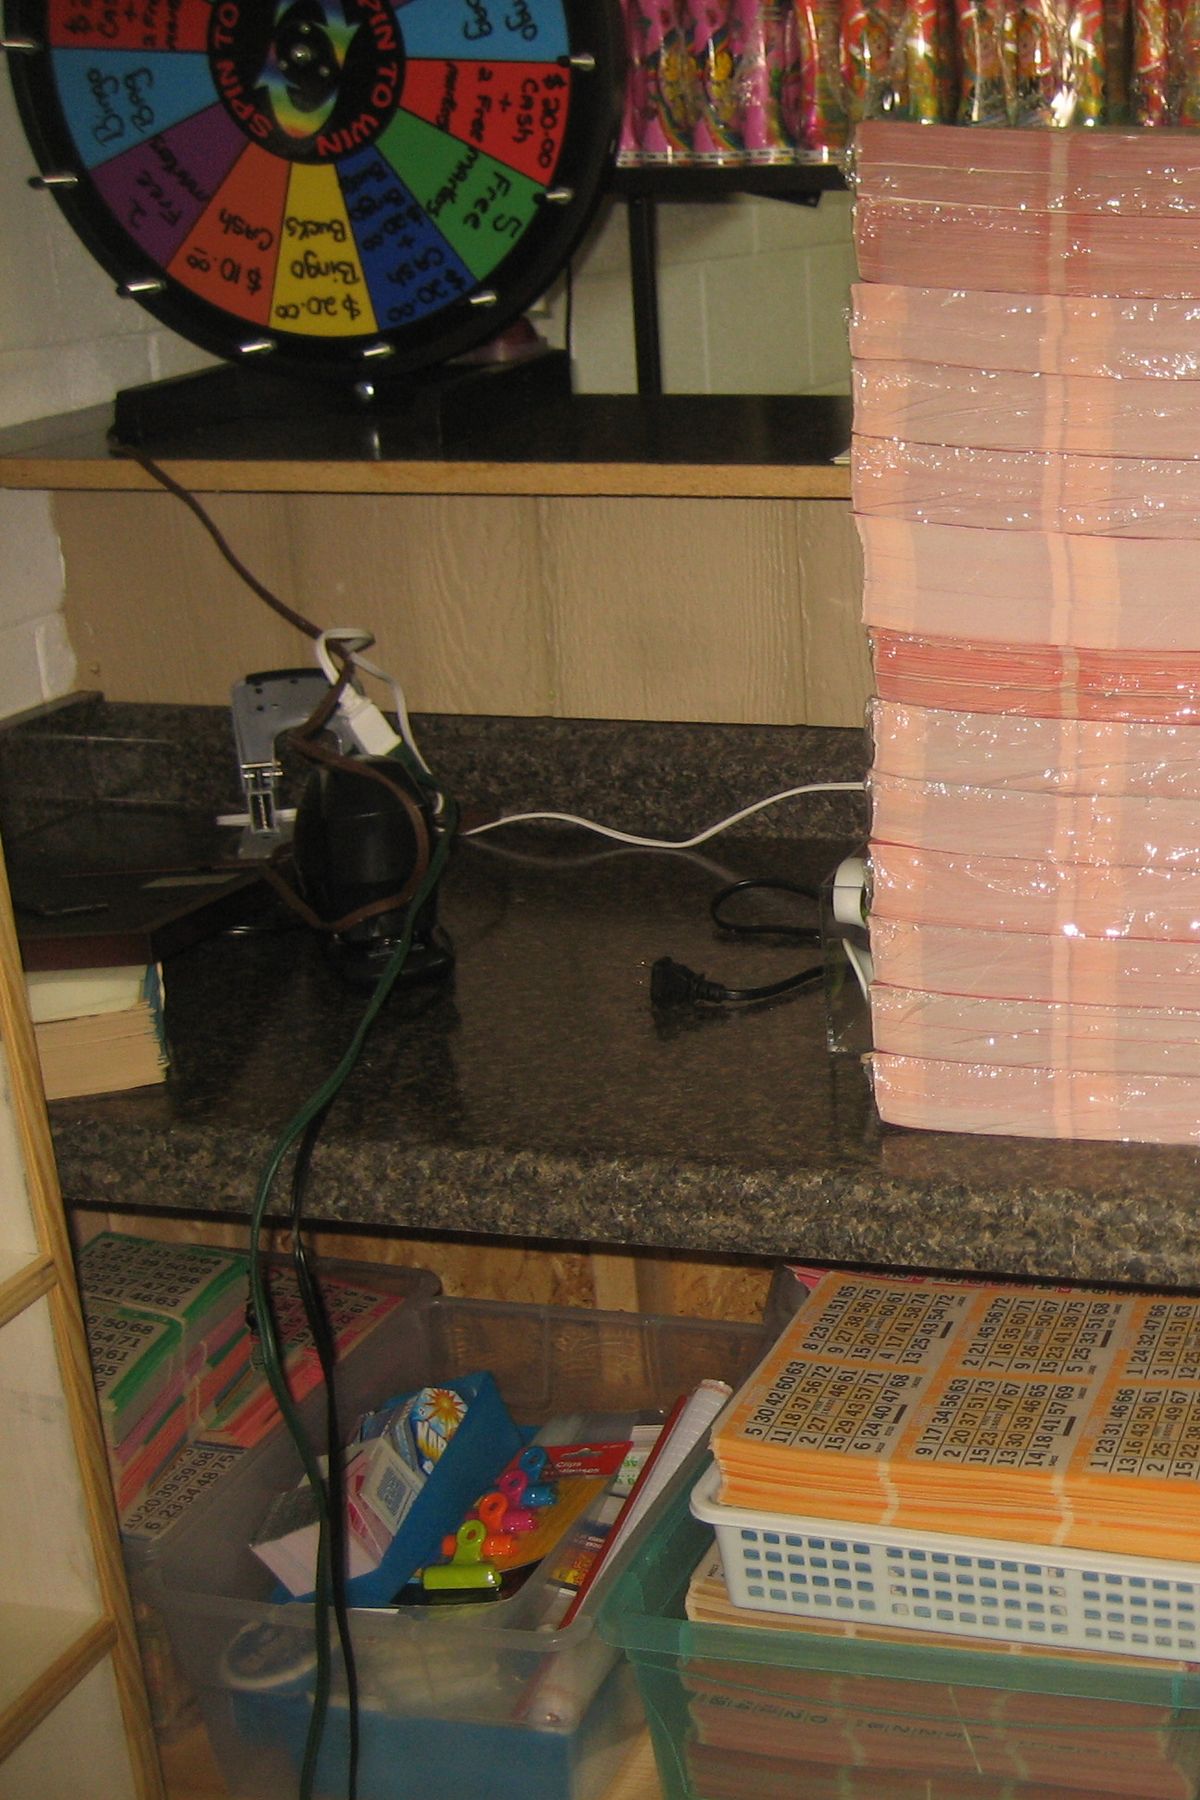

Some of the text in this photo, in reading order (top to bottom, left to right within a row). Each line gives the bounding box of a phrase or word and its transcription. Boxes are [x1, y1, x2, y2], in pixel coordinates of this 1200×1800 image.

[215, 2, 273, 139] SPIN TO
[371, 62, 398, 109] TO
[316, 113, 379, 157] WIN
[219, 207, 273, 251] Cash
[285, 215, 347, 243] Bucks
[462, 171, 513, 231] Free
[492, 212, 523, 239] 5
[290, 250, 361, 286] Bingo
[102, 1318, 153, 1334] 50 68
[745, 1361, 806, 1436] 5 30 42 60 63
[772, 1365, 833, 1444] 11 18 37 56 72
[800, 1370, 858, 1445] 2 27 46 61
[825, 1372, 883, 1450] 15 29 43 57 71
[854, 1374, 909, 1451] 6 24 40 47 68
[915, 1379, 969, 1456] 9 17 34 56 63
[943, 1381, 995, 1458] 2 20 37 51 73
[969, 1383, 1022, 1463] 15 23 47 67
